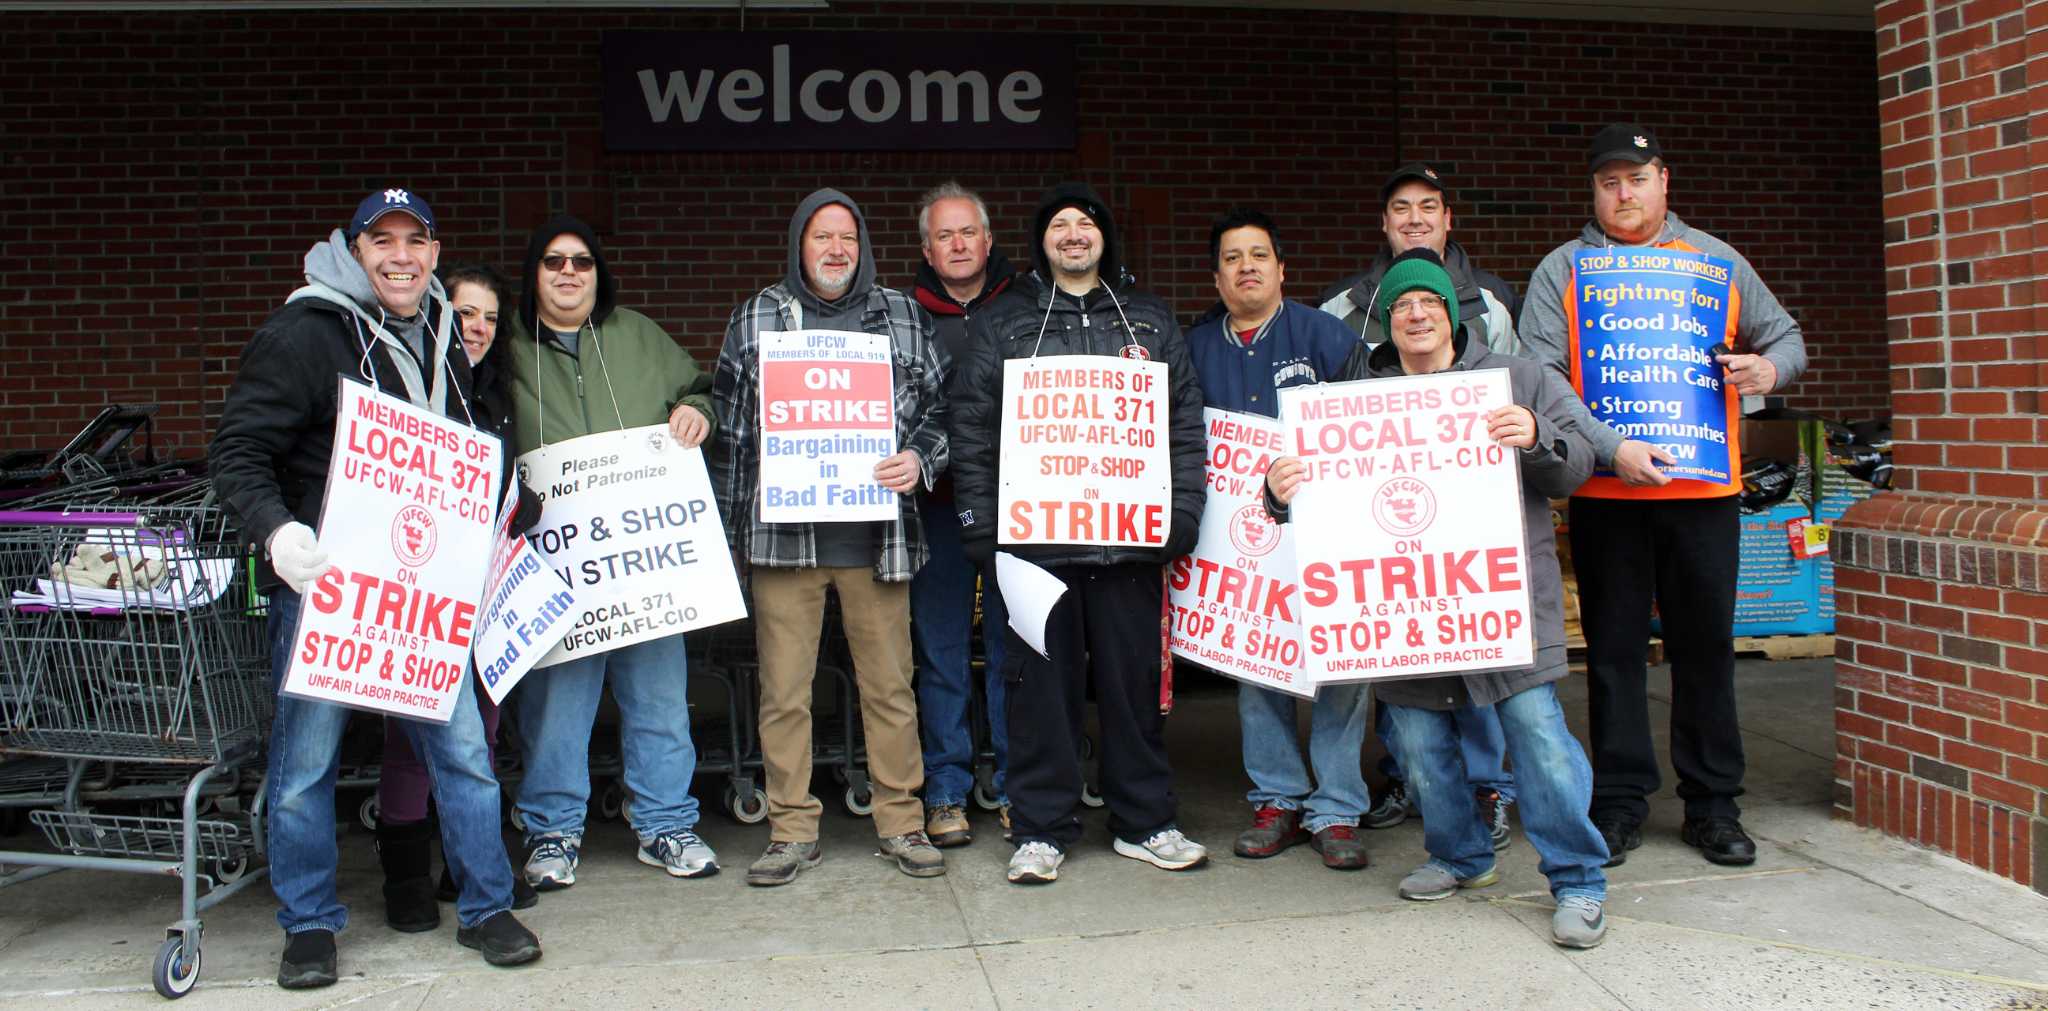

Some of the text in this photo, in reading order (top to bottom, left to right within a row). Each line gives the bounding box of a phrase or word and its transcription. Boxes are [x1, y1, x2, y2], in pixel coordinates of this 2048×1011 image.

[637, 44, 1043, 123] welcome
[384, 189, 409, 204] NY
[1580, 255, 1728, 281] STOP & SHOP WORKERS
[1584, 283, 1685, 308] Fighting
[1599, 313, 1708, 338] Good Jobs
[807, 335, 847, 348] UFCW
[767, 349, 885, 361] MEMBERS OF LOCAL 919
[1600, 343, 1711, 368] Affordable
[804, 368, 851, 390] ON
[1023, 369, 1153, 393] MEMBERS OF
[1274, 362, 1317, 387] COWBOYS
[1600, 365, 1719, 391] Health Care
[768, 400, 888, 424] STRIKE
[1017, 393, 1155, 424] LOCAL 371
[1300, 385, 1488, 421] MEMBERS OF
[1601, 396, 1683, 419] Strong
[358, 396, 490, 462] MEMBERS OF
[1020, 424, 1155, 448] UFCW-AFL-CIO
[1210, 419, 1285, 452] MEMBE
[1295, 417, 1427, 457] LOCAL
[766, 434, 891, 459] Bargaining
[348, 421, 491, 499] LOCAL 371
[562, 454, 620, 476] Please
[819, 460, 838, 478] in
[1040, 455, 1145, 479] STOP & SHOP
[344, 456, 490, 525] UFCW-AFL-CIO
[552, 480, 581, 499] Not
[586, 464, 667, 489] Patronize
[1084, 488, 1099, 500] ON
[1381, 481, 1424, 497] UFCW
[766, 484, 893, 507] Bad Faith
[402, 510, 432, 529] UFCW
[527, 498, 708, 554] TOP & SHOP
[1009, 500, 1163, 543] STRIKE
[1395, 539, 1422, 554] ON
[580, 540, 699, 585] STRIKE
[1236, 557, 1258, 572] ON
[397, 567, 418, 584] ON
[1303, 547, 1522, 608] STRIKE
[641, 592, 674, 611] 371
[1170, 554, 1301, 625] STRIK
[311, 564, 476, 648] STRIKE
[503, 608, 519, 629] in
[1197, 600, 1275, 630] AGAINST
[1360, 597, 1463, 618] AGAINST
[352, 626, 430, 652] AGAINST
[484, 640, 520, 688] Bad
[516, 590, 575, 647] Faith
[563, 606, 698, 652] UFCW-AFL-CIO
[1221, 623, 1236, 650] &
[1310, 609, 1522, 655] STOP & SHOP
[301, 631, 461, 694] STOP & SHOP
[1200, 647, 1233, 666] LABOR
[1235, 659, 1293, 683] PRACTICE
[1326, 648, 1504, 672] UNFAIR LABOR PRACTICE
[308, 673, 439, 711] UNFAIR LABOR PRACTICE
